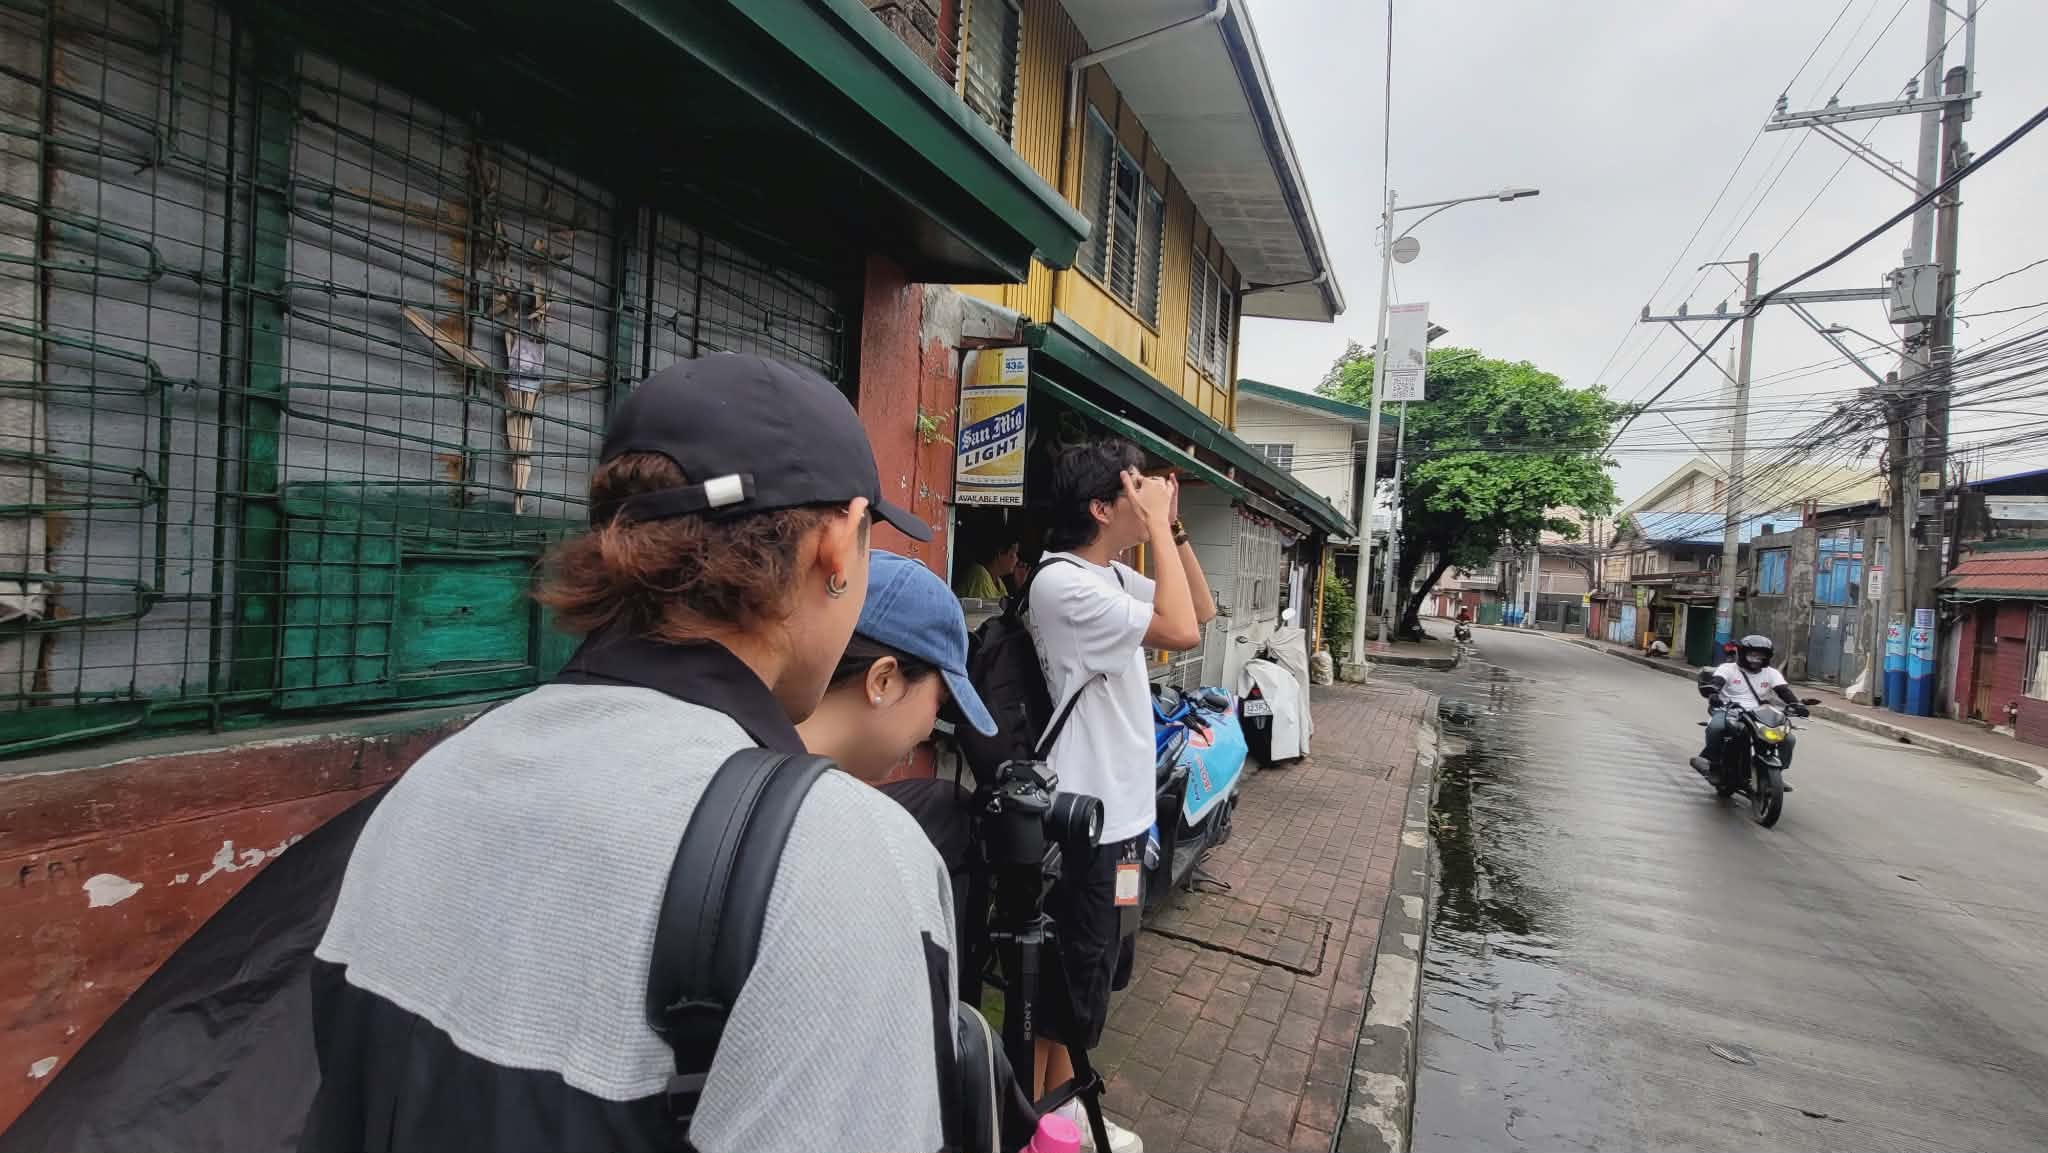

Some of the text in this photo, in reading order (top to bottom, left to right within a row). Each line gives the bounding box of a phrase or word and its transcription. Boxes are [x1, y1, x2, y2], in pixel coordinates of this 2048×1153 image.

[961, 410, 1023, 450] San Mig
[965, 436, 1018, 467] LIGHT
[958, 495, 1021, 504] AVAILABLE HERE
[1023, 1000, 1031, 1041] SONY
